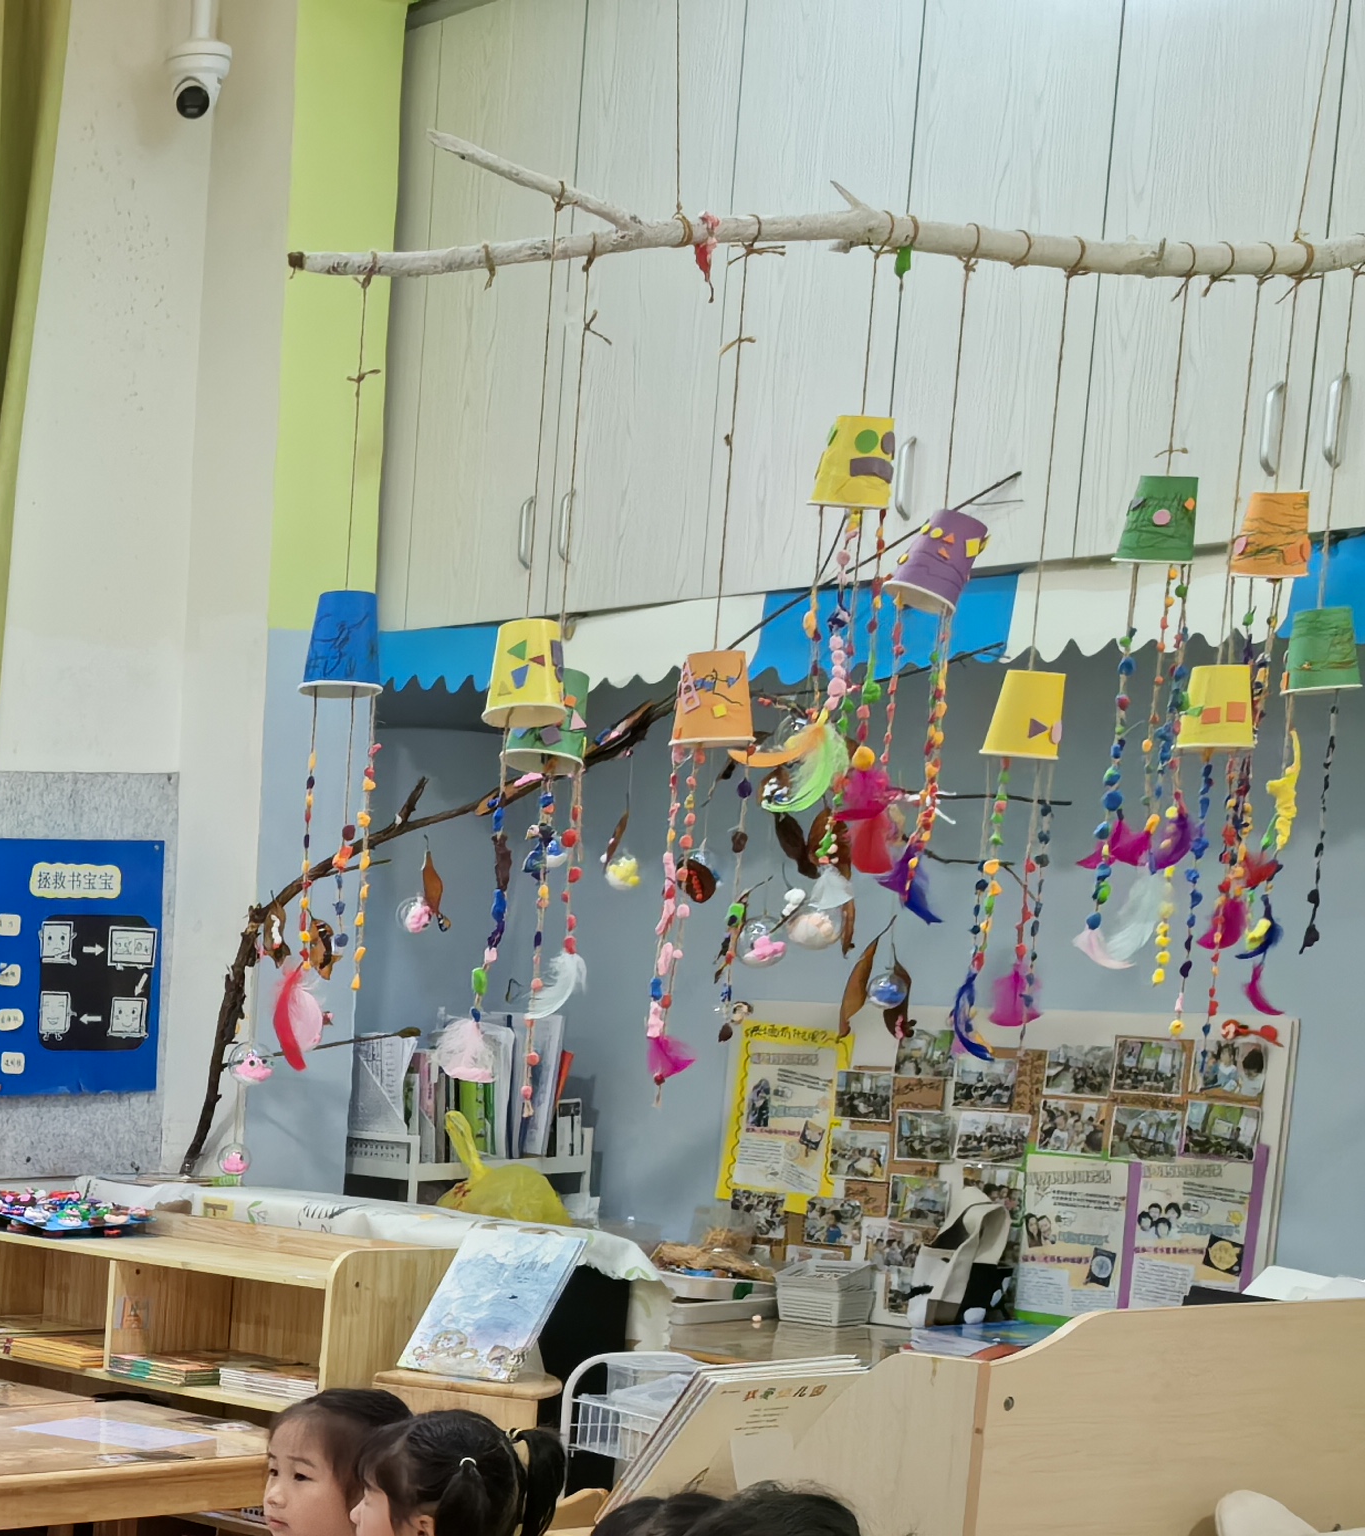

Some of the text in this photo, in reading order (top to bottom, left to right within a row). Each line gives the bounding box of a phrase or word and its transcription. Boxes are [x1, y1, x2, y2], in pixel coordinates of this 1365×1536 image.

[37, 871, 114, 891] 拯救书宝宝
